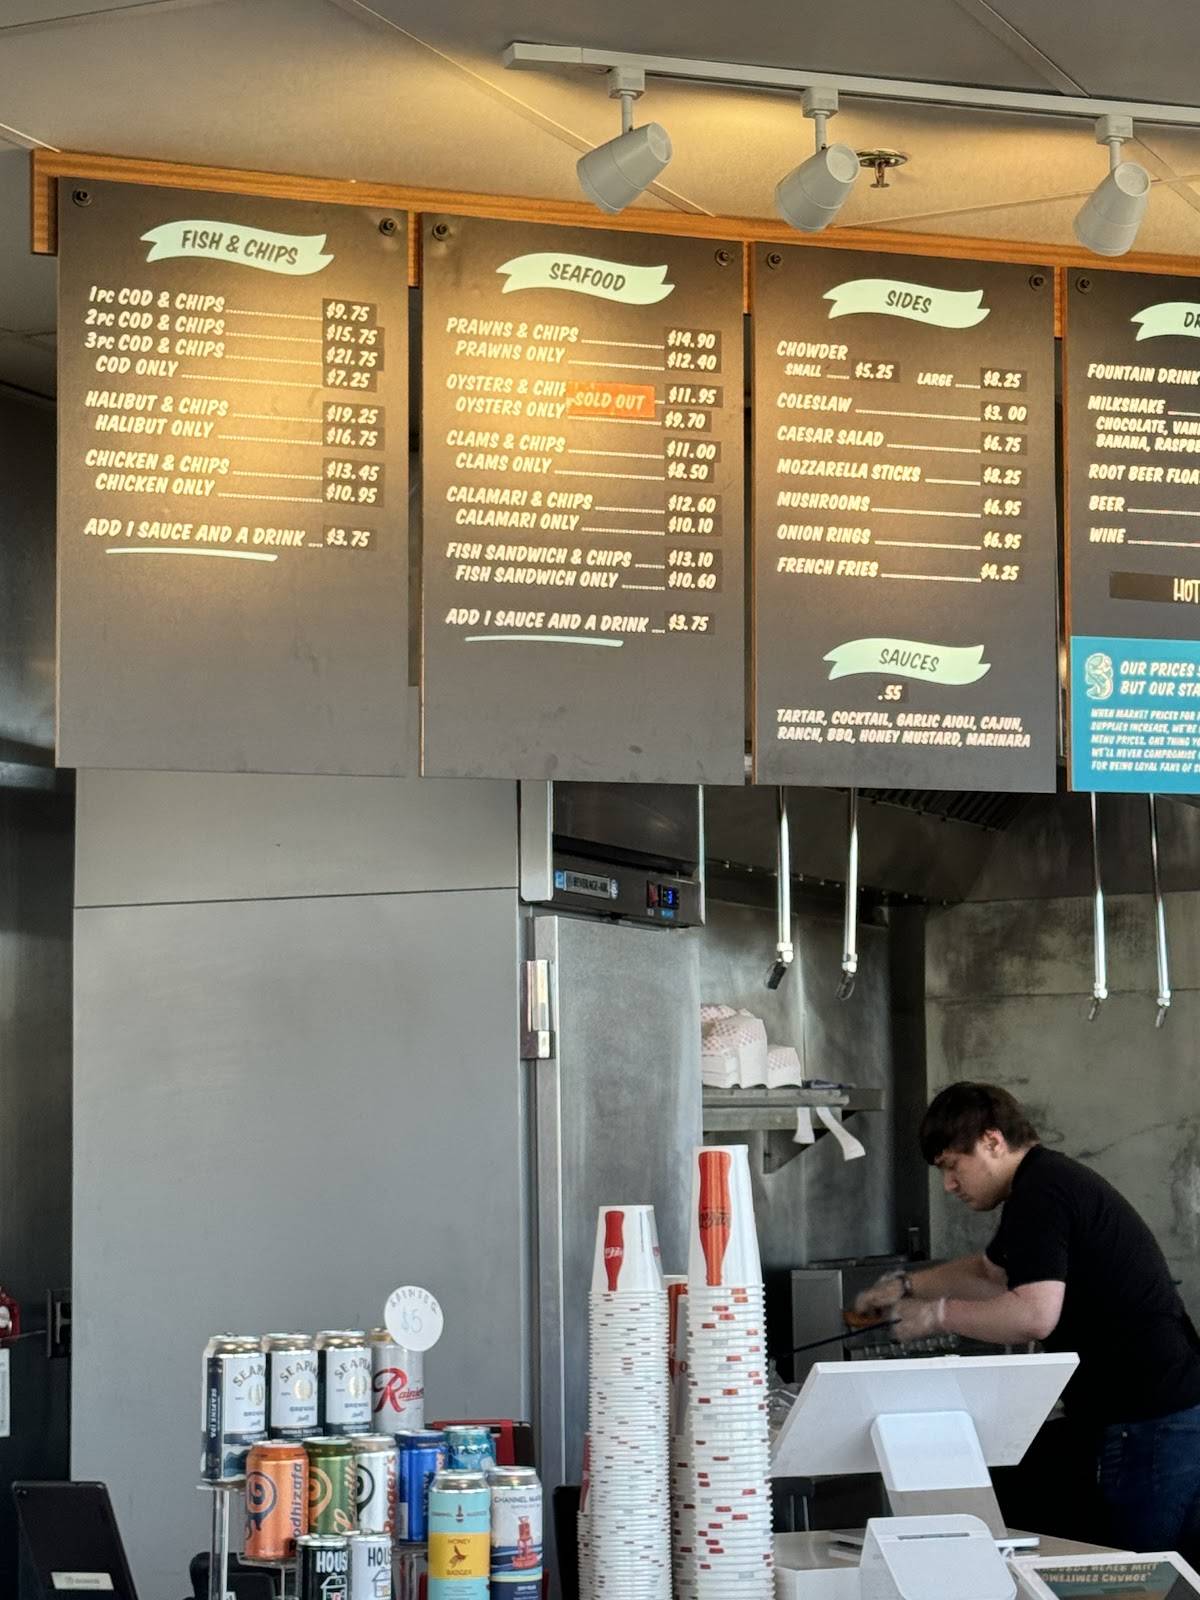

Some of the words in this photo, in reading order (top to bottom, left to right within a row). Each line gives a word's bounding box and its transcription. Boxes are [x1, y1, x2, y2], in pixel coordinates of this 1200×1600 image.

[181, 230, 222, 250] FISH
[226, 235, 239, 253] &
[244, 239, 299, 265] CHIPS
[549, 263, 625, 291] SEAFOOD
[118, 288, 152, 306] COD
[157, 292, 170, 307] &
[175, 292, 225, 313] CHIPS
[326, 303, 370, 322] $9.75
[886, 290, 932, 314] SIDES
[117, 312, 152, 330] COD
[157, 315, 170, 331] &
[175, 316, 225, 336] CHIPS
[326, 325, 377, 345] $15.75
[446, 317, 513, 338] PRAWNS
[516, 322, 528, 338] &
[533, 324, 578, 343] CHIPS
[667, 330, 715, 349] $14.90
[117, 335, 152, 352] COD
[157, 338, 170, 353] &
[175, 339, 225, 359] CHIPS
[326, 348, 377, 367] $21.75
[455, 341, 521, 360] PRAWNS
[526, 346, 565, 364] ONLY
[667, 352, 717, 371] $12.40
[777, 341, 848, 360] CHOWDER
[96, 355, 131, 374] COD
[135, 358, 178, 377] ONLY
[326, 371, 370, 388] $7.25
[784, 363, 821, 377] SMALL
[855, 362, 894, 380] $5.25
[917, 373, 953, 387] LARGE
[983, 371, 1021, 388] $8.25
[1088, 363, 1155, 383] FOUNTAIN
[446, 374, 512, 394] OYSTERS
[517, 379, 528, 394] &
[669, 387, 716, 404] $11.95
[85, 391, 157, 411] HALIBUT
[161, 396, 173, 412] &
[178, 397, 228, 416] CHIPS
[326, 406, 378, 425] $19.25
[455, 397, 522, 416] OYSTERS
[526, 402, 566, 419] ONLY
[665, 412, 706, 429] $9.70
[570, 392, 612, 409] SOLD
[615, 394, 646, 410] OUT
[777, 393, 852, 412] COLESLAW
[1088, 395, 1165, 415] MILKSHAKE
[96, 415, 167, 434] HALIBUT
[171, 419, 213, 438] ONLY
[326, 429, 377, 447] $16.75
[1096, 416, 1168, 435] CHOCOLATE,
[446, 430, 499, 448] CLAMS
[503, 434, 514, 449] &
[520, 435, 565, 453] CHIPS
[667, 441, 716, 460] $11.00
[777, 425, 833, 445] CAESAR
[837, 430, 884, 448] SALAD
[983, 435, 1021, 453] $6.75
[1096, 434, 1151, 452] BANANA,
[85, 449, 158, 470] CHICKEN
[162, 454, 174, 471] &
[180, 455, 230, 474] CHIPS
[326, 462, 379, 481] $13.45
[455, 453, 508, 470] CLAMS
[512, 456, 551, 474] ONLY
[667, 462, 708, 479] $8.50
[777, 459, 868, 479] MOZZARELLA
[871, 464, 921, 482] STICKS
[983, 467, 1022, 485] $8.25
[1088, 464, 1126, 480] ROOT
[1128, 466, 1163, 482] BEER
[96, 474, 168, 493] CHICKEN
[173, 478, 215, 497] ONLY
[326, 484, 377, 503] $10.95
[446, 487, 528, 506] CALAMARI
[531, 492, 543, 507] &
[547, 492, 593, 510] CHIPS
[667, 496, 716, 513] $12.60
[777, 491, 870, 512] MUSHROOMS
[983, 498, 1022, 516] $6.95
[1089, 495, 1125, 512] BEER
[84, 518, 121, 536] ADD
[137, 522, 193, 540] SAUCE
[195, 525, 231, 543] AND
[235, 527, 249, 544] A
[253, 528, 305, 547] DRINK
[326, 529, 370, 547] $3.75
[455, 509, 537, 528] CALAMARI
[540, 514, 579, 531] ONLY
[667, 516, 713, 533] $10.10
[777, 524, 823, 541] ONION
[826, 527, 871, 545] RINGS
[983, 531, 1021, 549] $6.95
[1089, 527, 1126, 543] WINE
[446, 543, 482, 559] FISH
[485, 545, 566, 564] SANDWICH
[571, 550, 582, 565] &
[586, 550, 632, 568] CHIPS
[667, 551, 713, 568] $13.10
[455, 565, 491, 581] FISH
[494, 567, 575, 586] SANDWICH
[579, 571, 618, 589] ONLY
[667, 572, 716, 589] $10.60
[777, 558, 833, 576] FRENCH
[836, 560, 878, 578] FRIES
[980, 563, 1019, 581] $4.25
[1173, 578, 1200, 604] HOT
[445, 609, 480, 624] ADD
[495, 611, 545, 628] SAUCE
[547, 613, 581, 630] AND
[585, 615, 597, 630] A
[600, 616, 649, 632] DRINK
[668, 615, 709, 631] $3.75
[879, 648, 940, 672] SAUCES
[1120, 661, 1147, 675] OUR
[1150, 663, 1193, 677] PRICES
[878, 685, 902, 700] .55
[1120, 681, 1145, 695] BUT
[1149, 683, 1174, 696] OUR
[777, 709, 828, 725] TARTAR,
[832, 712, 892, 728] COCKTAIL,
[896, 713, 940, 728] GARLIC
[943, 716, 976, 730] AIOLI,
[980, 717, 1023, 732] CAJUN,
[1091, 709, 1114, 718] WHEN
[1116, 709, 1149, 719] MARKET
[1150, 711, 1179, 720] PRICES
[1179, 712, 1195, 720] FOR
[1091, 722, 1127, 731] SUPPLIES
[778, 727, 823, 742] RANCH,
[827, 729, 856, 744] BBQ,
[859, 730, 900, 744] HONEY
[902, 731, 962, 748] MUSTARD,
[966, 732, 1031, 748] MARINARA
